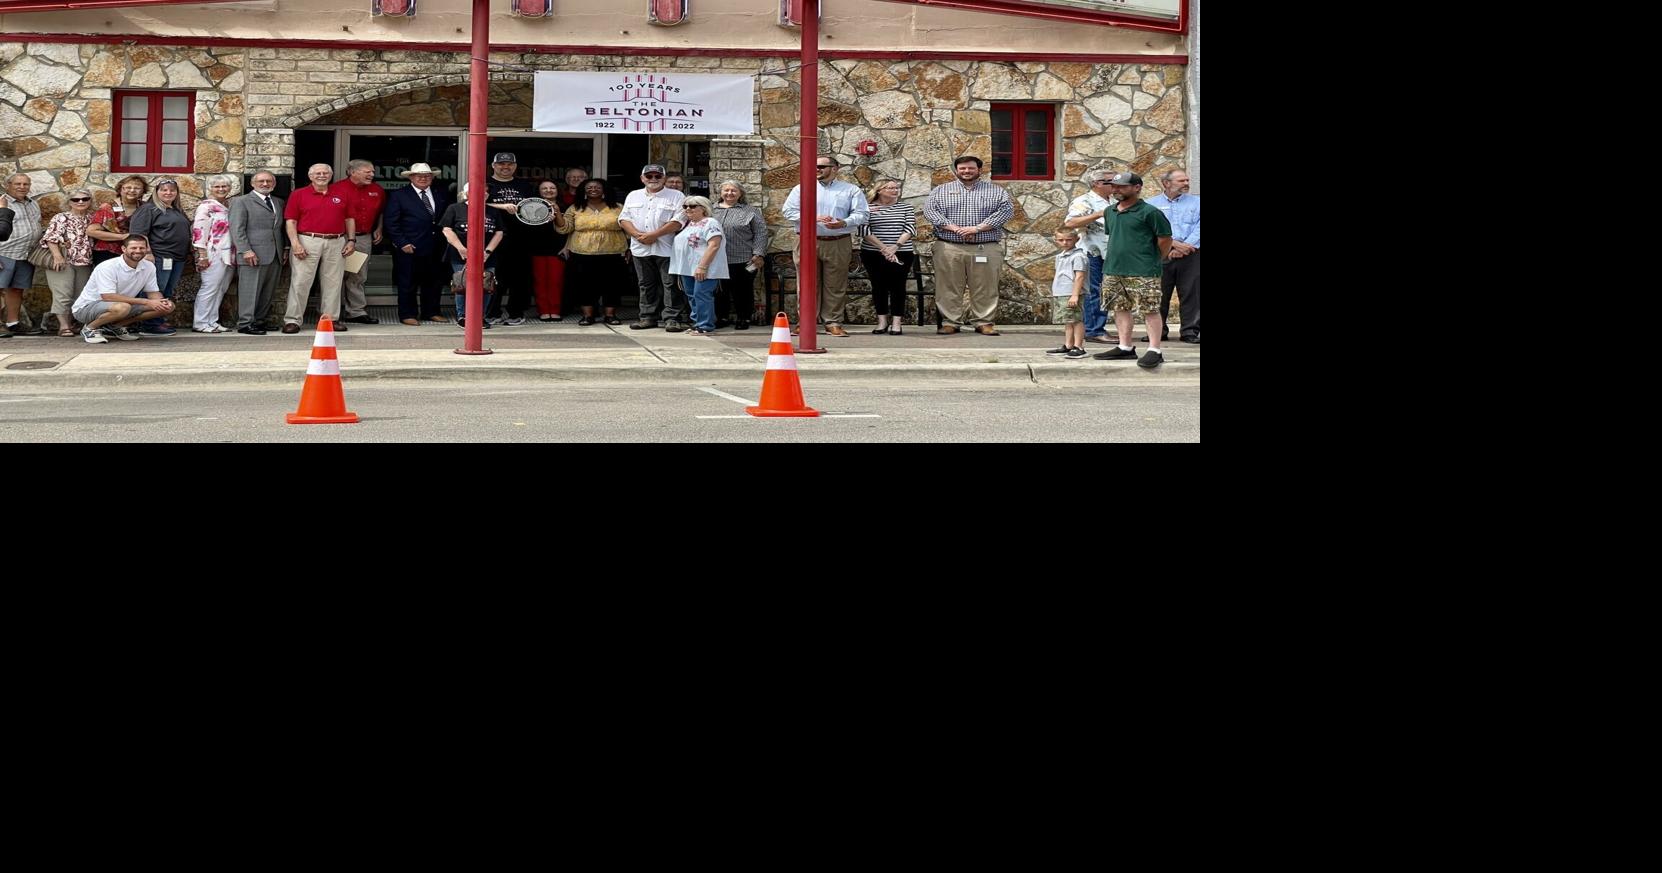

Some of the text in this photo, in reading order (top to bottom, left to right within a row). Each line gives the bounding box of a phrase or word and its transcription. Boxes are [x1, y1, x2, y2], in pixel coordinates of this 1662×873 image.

[609, 83, 681, 94] 100 YEARS
[584, 107, 704, 117] BELTONIAN
